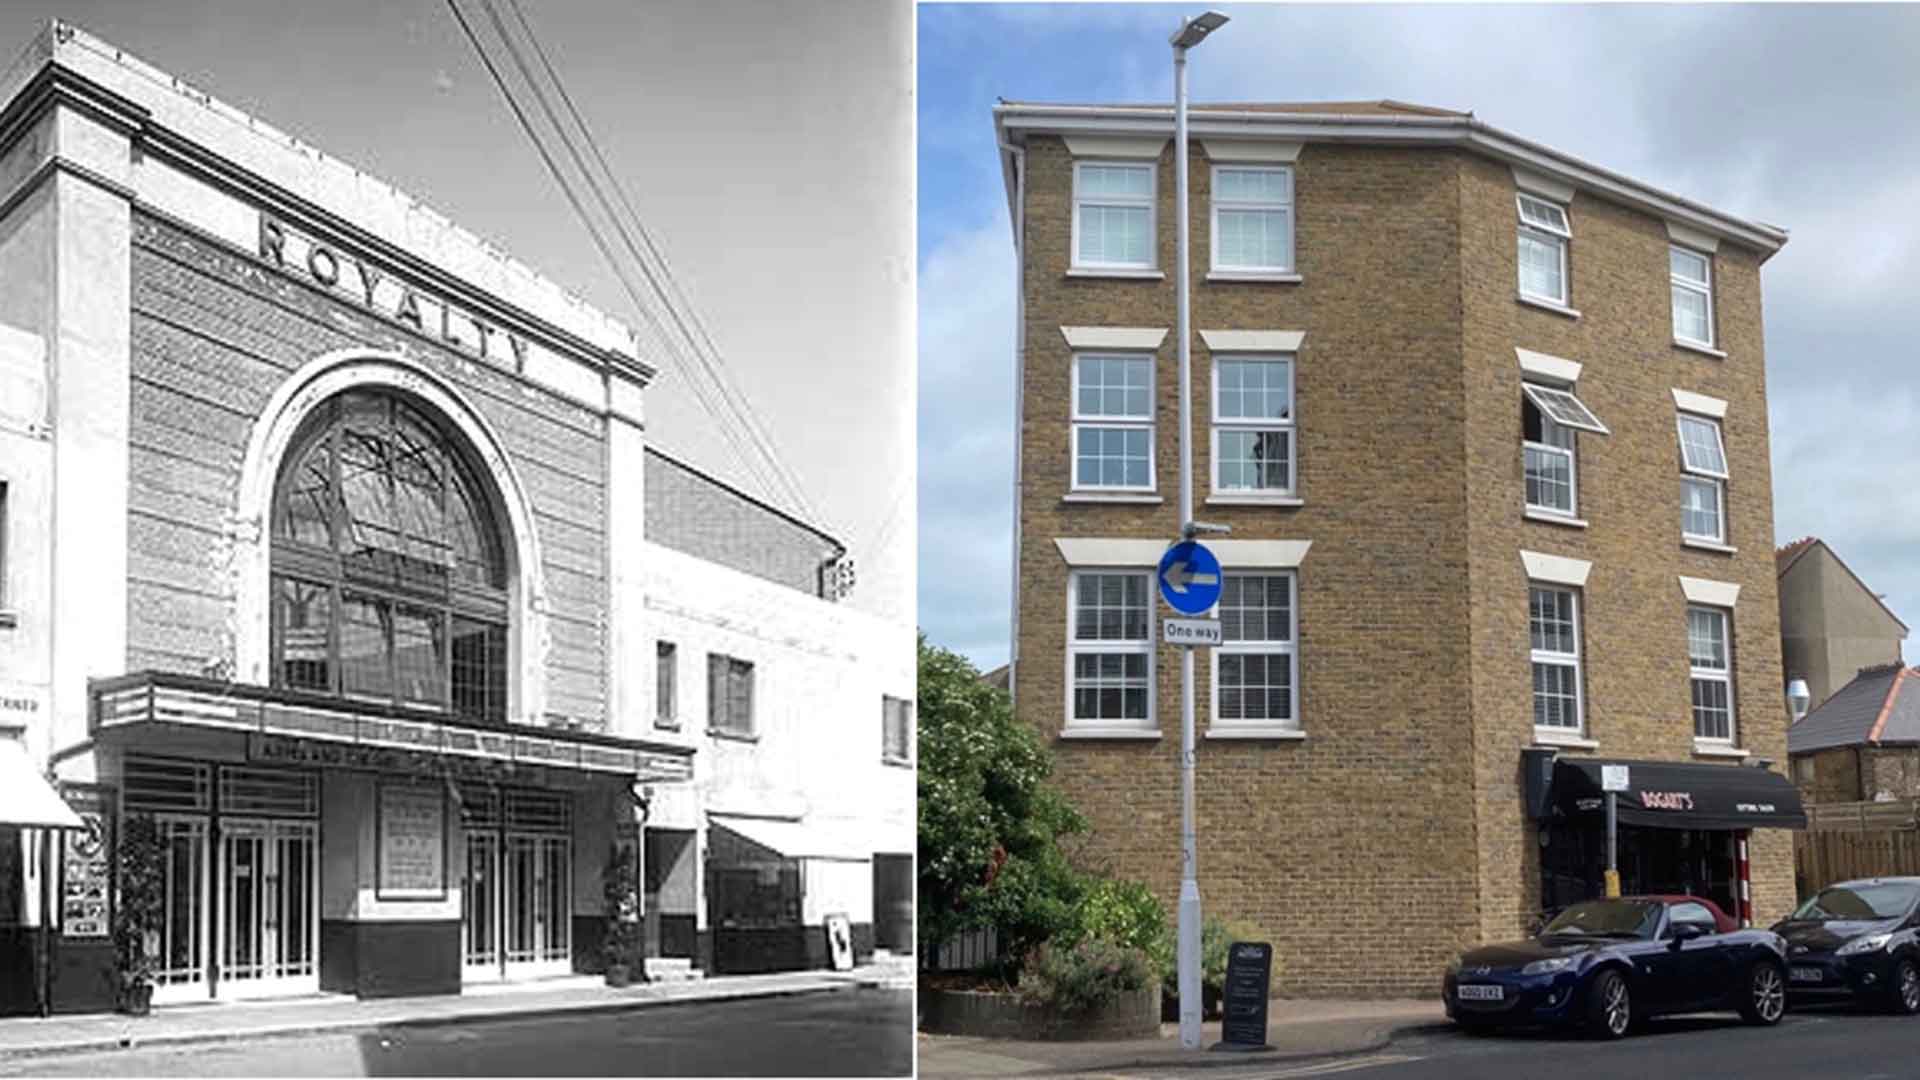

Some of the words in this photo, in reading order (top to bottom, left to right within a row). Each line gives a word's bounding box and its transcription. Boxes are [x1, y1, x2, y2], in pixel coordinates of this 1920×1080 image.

[258, 208, 528, 374] ROYALTY
[1167, 623, 1193, 638] One
[1195, 626, 1219, 641] way
